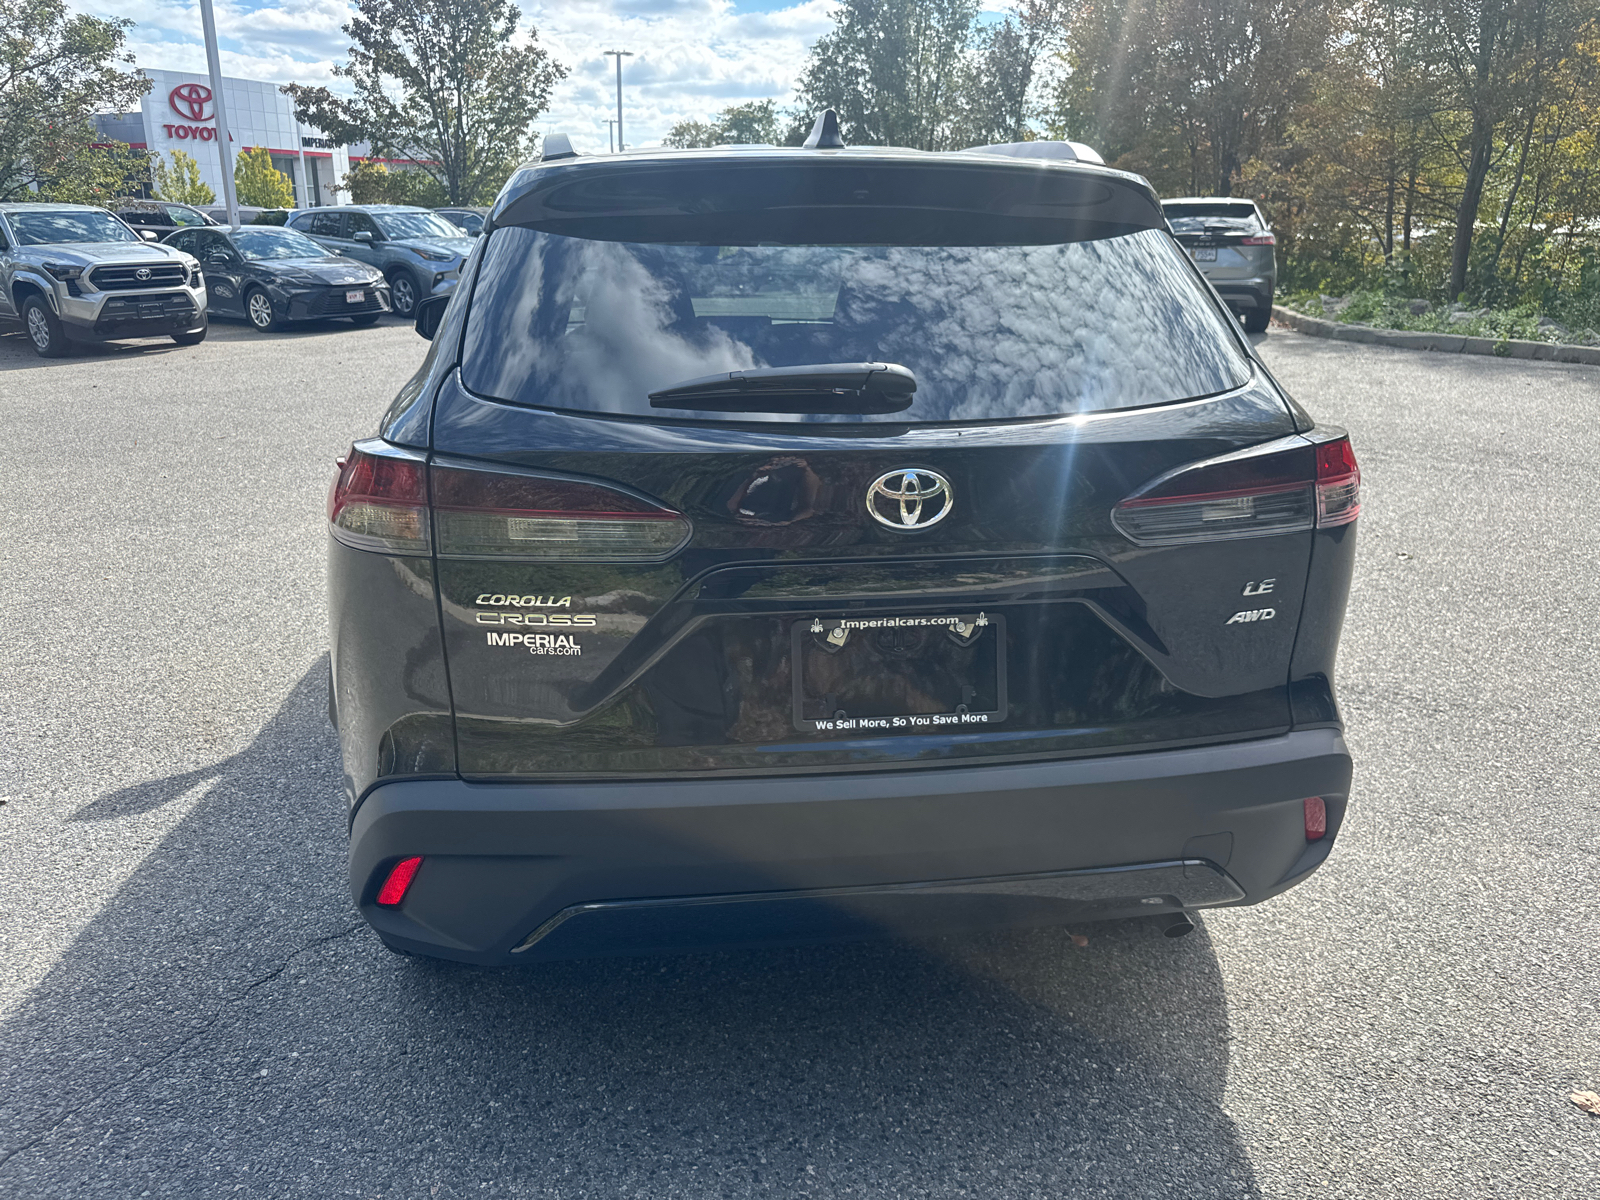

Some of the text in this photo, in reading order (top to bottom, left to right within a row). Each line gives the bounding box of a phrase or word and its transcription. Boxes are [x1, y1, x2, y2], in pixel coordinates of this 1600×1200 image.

[1242, 578, 1276, 596] LE
[476, 593, 572, 607] COROLLA
[475, 612, 597, 627] CROSS
[840, 617, 959, 630] Imperialcars.com
[1225, 607, 1276, 625] AWD
[486, 632, 581, 648] IMPERIAL
[530, 646, 581, 656] cars.com
[815, 714, 988, 730] We Sell More, So You Save More
